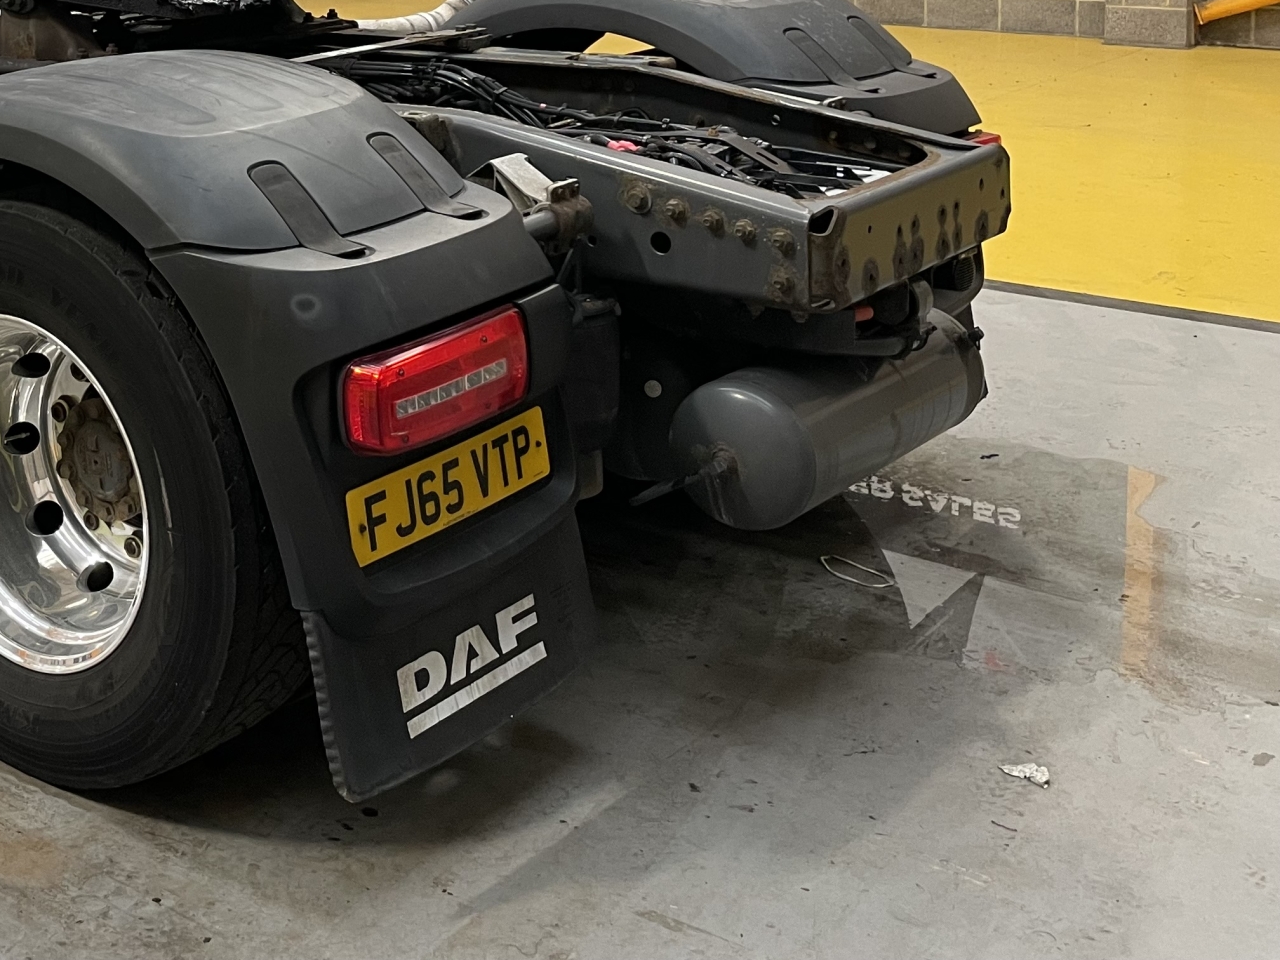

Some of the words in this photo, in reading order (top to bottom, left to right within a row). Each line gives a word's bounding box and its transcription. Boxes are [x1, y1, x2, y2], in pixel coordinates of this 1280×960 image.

[363, 456, 466, 553] FJ65
[469, 424, 532, 499] VTP
[396, 593, 540, 714] DAF
